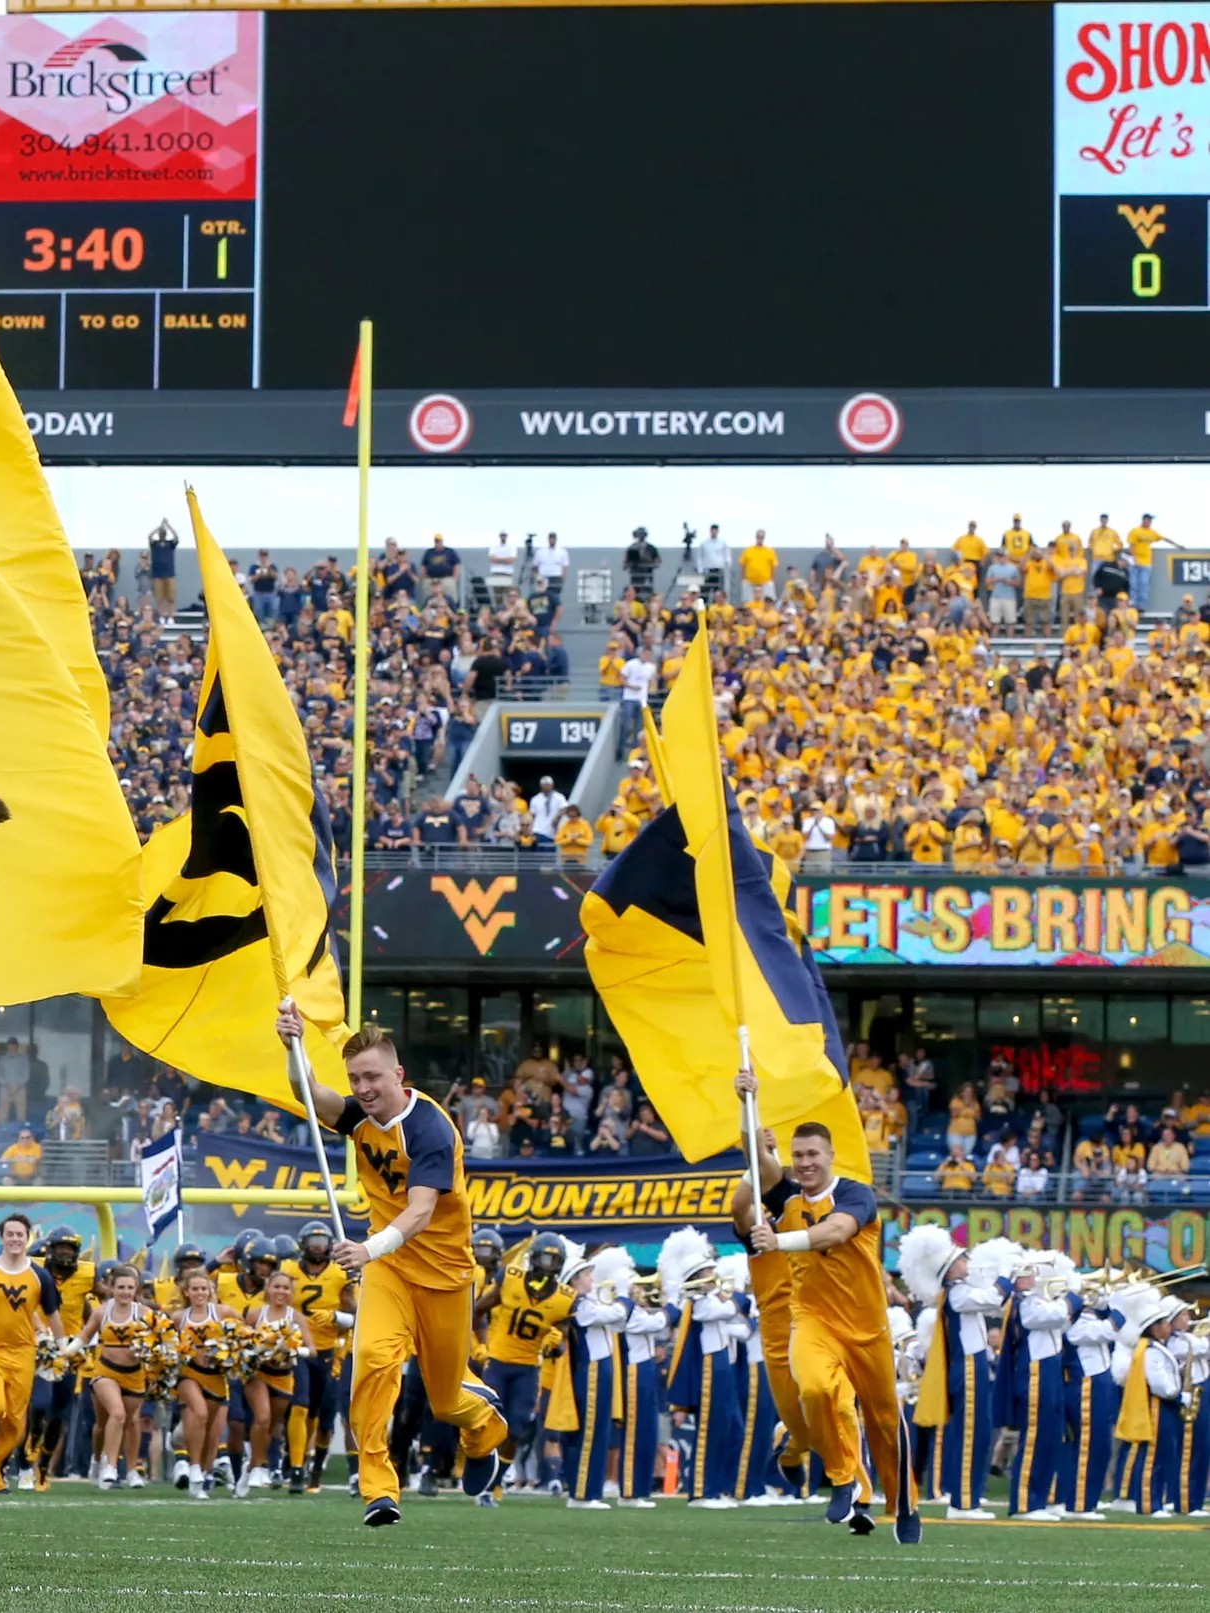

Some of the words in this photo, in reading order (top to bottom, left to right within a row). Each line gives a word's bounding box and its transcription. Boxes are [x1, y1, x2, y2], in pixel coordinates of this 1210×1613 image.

[19, 132, 214, 157] 304.941.1000
[1079, 103, 1195, 176] Let's
[19, 166, 214, 182] www.brickstreet.com
[200, 220, 247, 235] QTR.
[23, 227, 145, 272] 3:40
[217, 237, 228, 279] 1
[79, 314, 105, 329] TO
[111, 314, 140, 329] GO
[163, 314, 213, 329] BALL
[218, 313, 247, 329] ON
[23, 411, 114, 436] ODAY!
[520, 410, 785, 436] WVLOTTERY.COM
[509, 721, 538, 744] 97
[559, 721, 596, 744] 134
[795, 882, 974, 953] LET'S
[990, 885, 1191, 953] BRING
[300, 1284, 323, 1317] 2
[507, 1307, 544, 1340] 16
